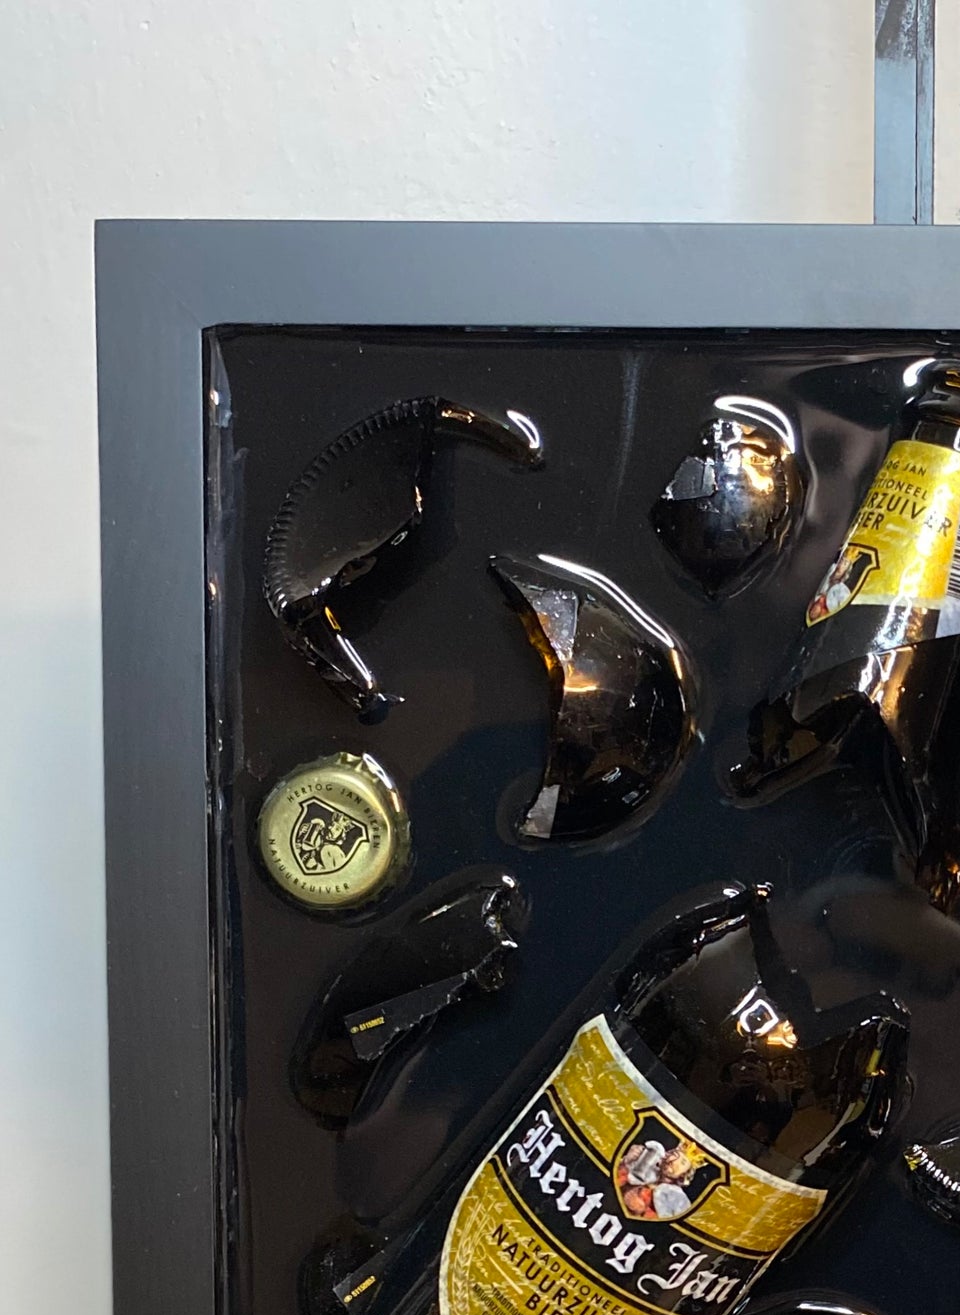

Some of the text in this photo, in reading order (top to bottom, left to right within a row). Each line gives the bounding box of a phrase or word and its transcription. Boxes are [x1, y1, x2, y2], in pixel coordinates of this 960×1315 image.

[903, 462, 927, 477] JAN
[858, 511, 885, 531] IER
[286, 783, 333, 803] HERTOG
[340, 788, 362, 805] JAN
[268, 838, 350, 894] NATUURZUIVER
[506, 1109, 655, 1274] Hertog
[637, 1242, 741, 1304] Jan
